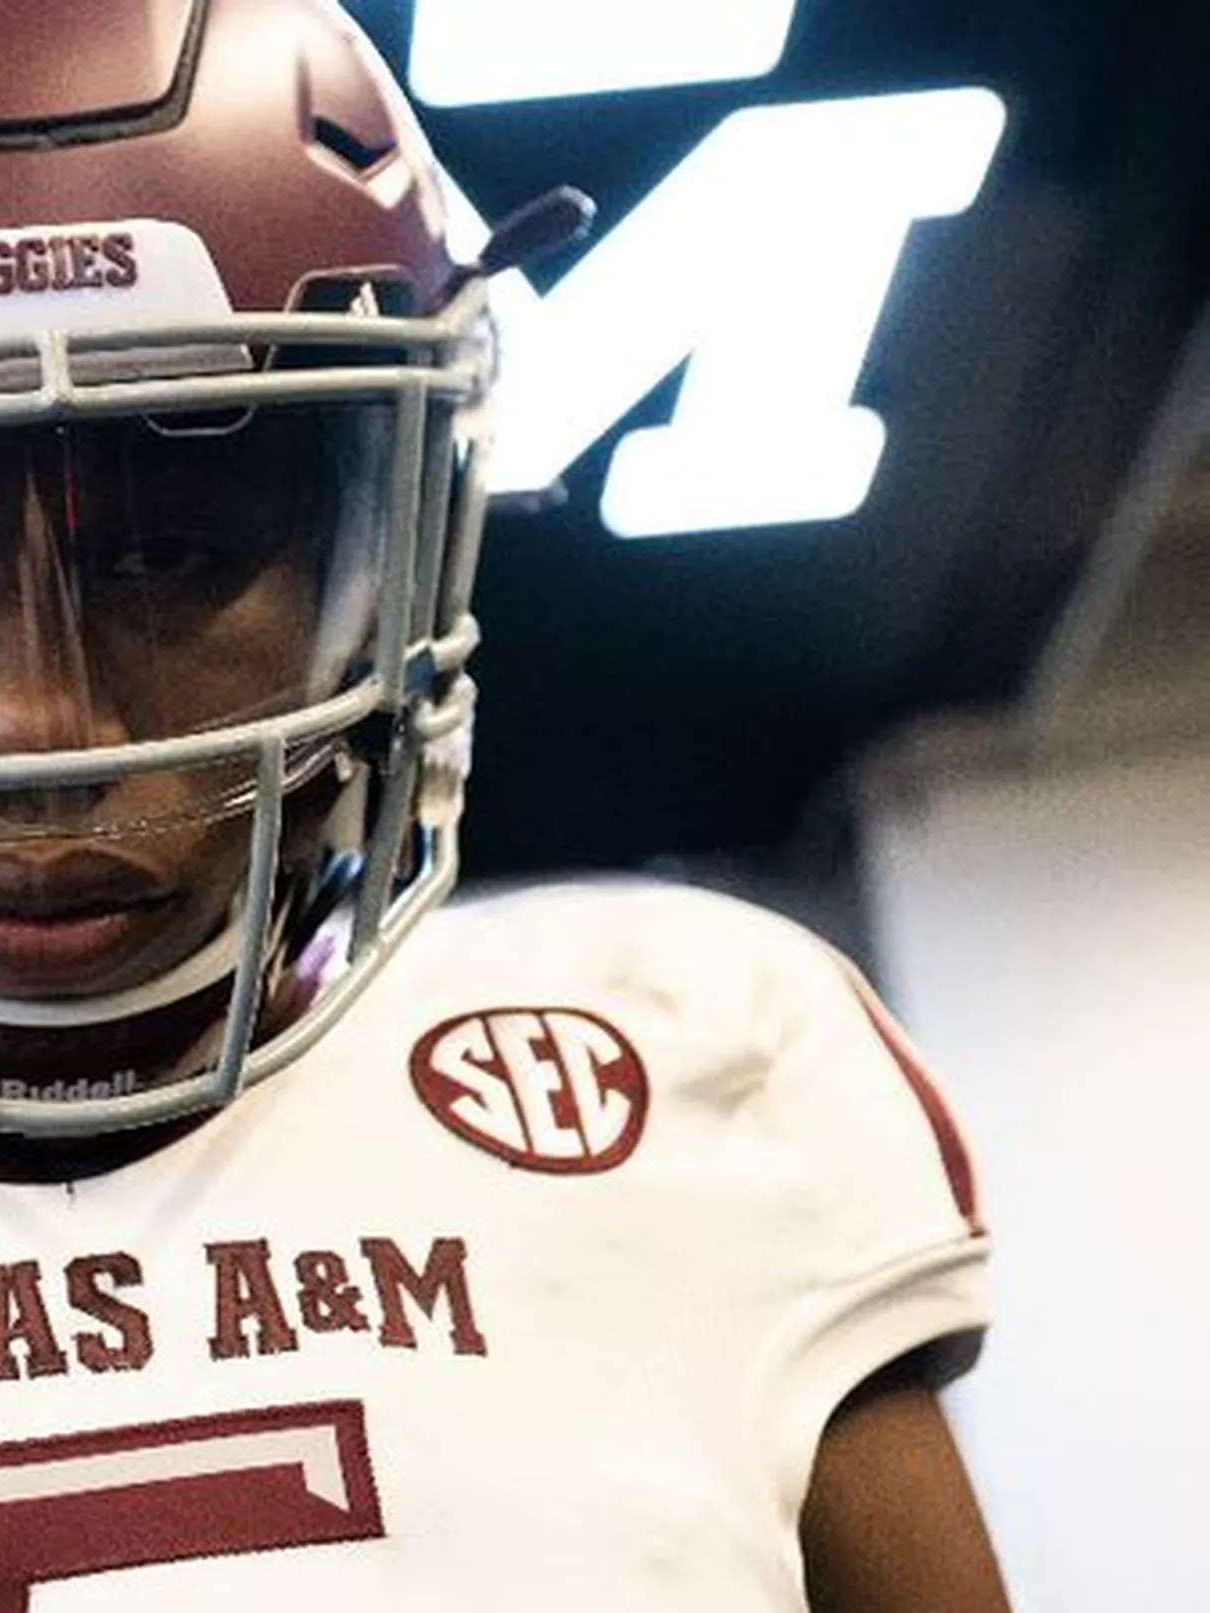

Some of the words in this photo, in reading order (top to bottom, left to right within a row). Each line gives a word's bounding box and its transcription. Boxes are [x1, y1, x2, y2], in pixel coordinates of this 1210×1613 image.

[0, 1068, 138, 1100] Riddell
[427, 1013, 635, 1160] SEC
[204, 1237, 489, 1361] A&M
